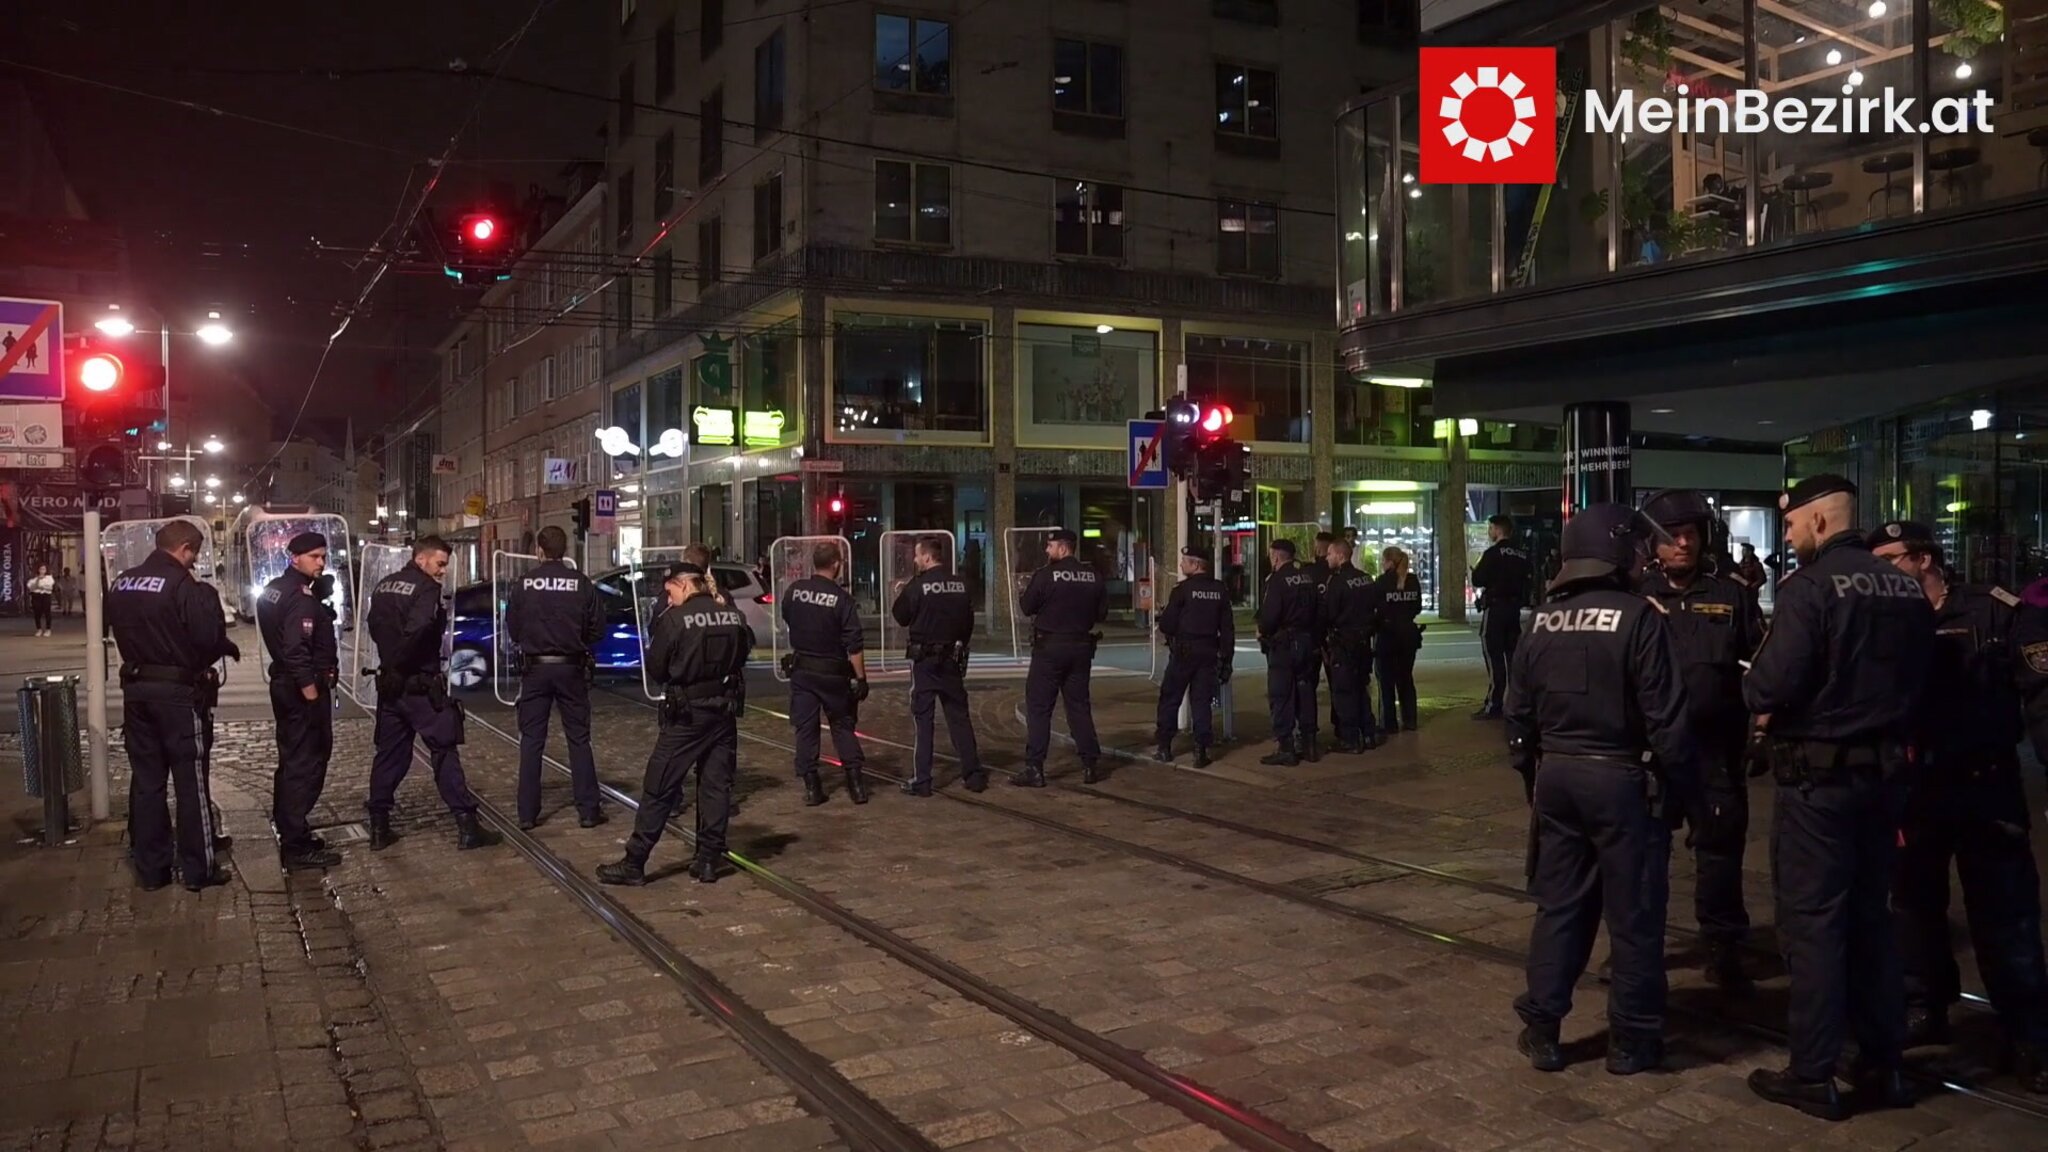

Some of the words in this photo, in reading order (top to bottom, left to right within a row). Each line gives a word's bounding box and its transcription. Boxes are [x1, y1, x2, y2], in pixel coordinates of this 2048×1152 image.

[439, 458, 454, 468] dm
[1580, 461, 1609, 472] MEHR
[19, 496, 68, 508] VERO
[74, 496, 121, 508] MD
[3, 542, 12, 569] VERO
[1053, 570, 1096, 583] POLIZEI
[3, 571, 12, 602] MODA
[524, 577, 579, 592] POLIZEI
[922, 581, 966, 596] POLIZEI
[1831, 572, 1925, 599] POLIZEI
[792, 589, 839, 608] POLIZEI
[1191, 590, 1221, 600] POLIZEI
[683, 611, 742, 629] POLIZEI
[1532, 607, 1622, 634] POLIZEI
